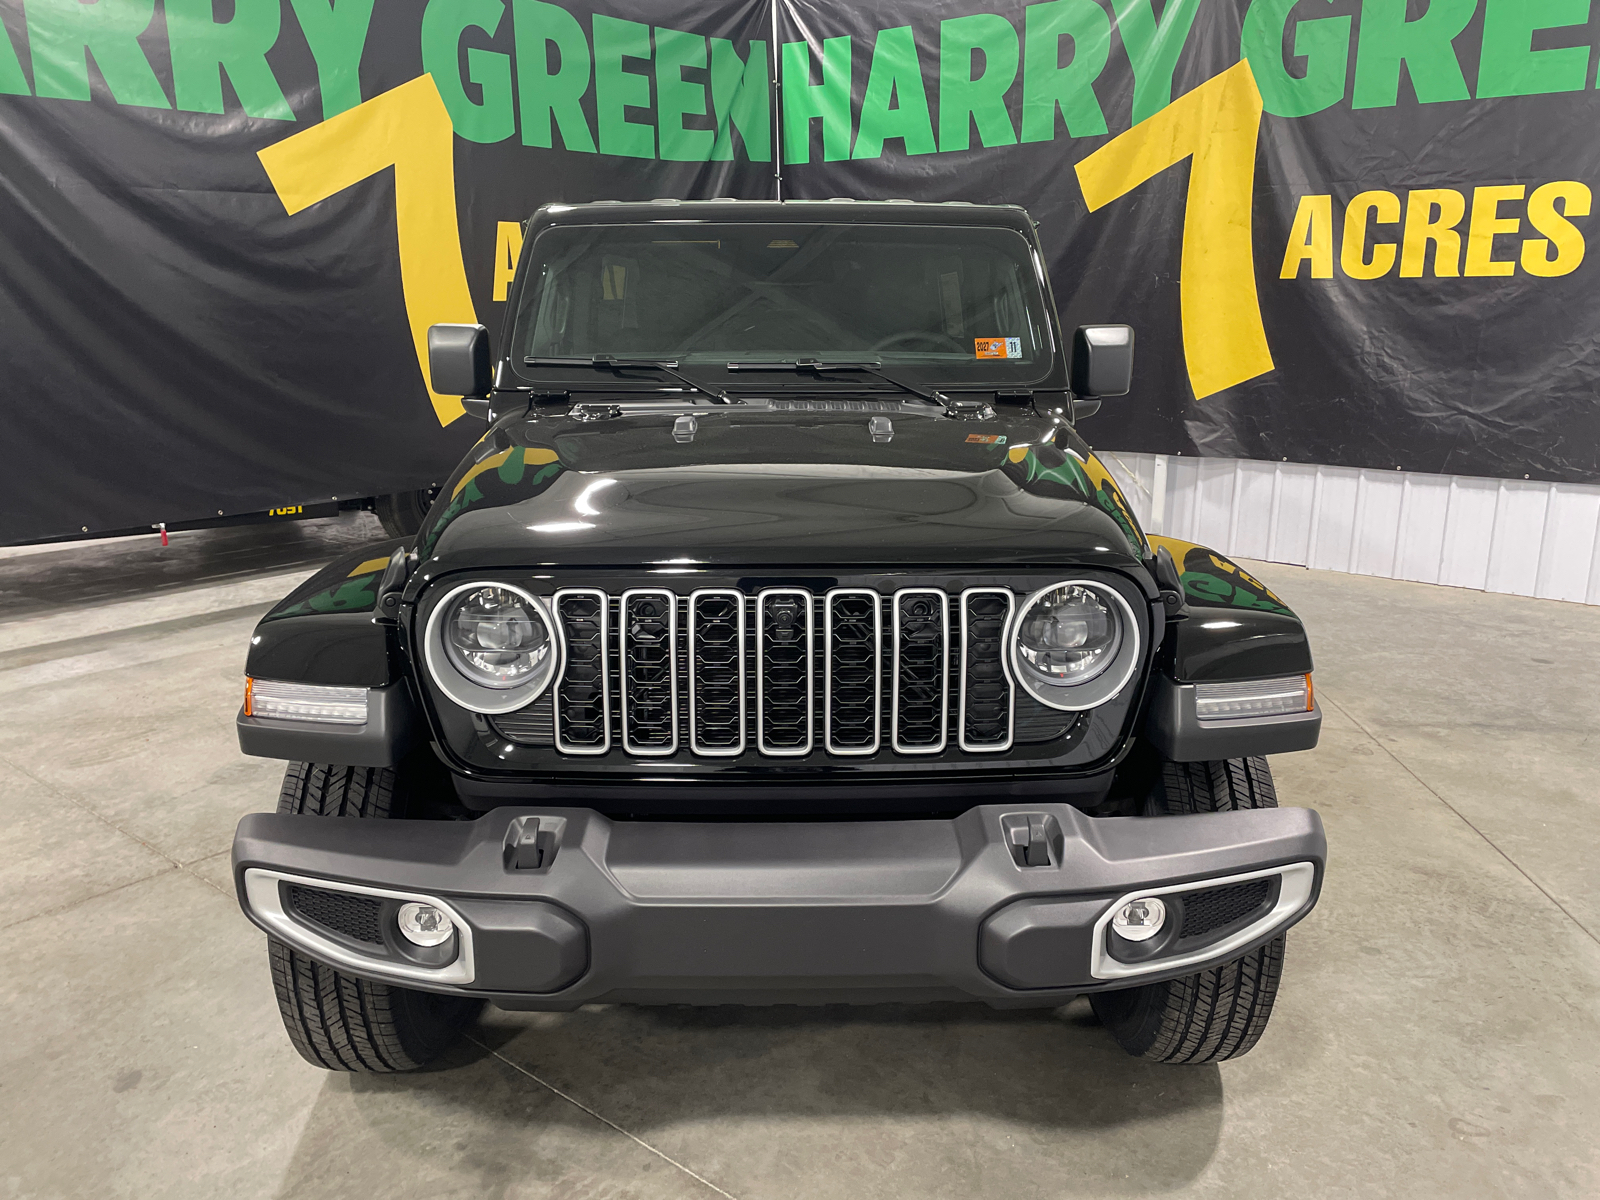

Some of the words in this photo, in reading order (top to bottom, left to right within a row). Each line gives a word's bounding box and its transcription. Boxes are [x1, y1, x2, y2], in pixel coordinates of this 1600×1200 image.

[0, 0, 374, 121] RRY
[421, 0, 771, 162] GREEN
[782, 0, 1198, 164] HARRY
[1240, 0, 1600, 117] GRE
[258, 72, 494, 428] 7
[1074, 58, 1275, 400] 7
[1279, 181, 1592, 280] ACRES
[976, 341, 989, 352] 2027
[1009, 341, 1017, 353] 11
